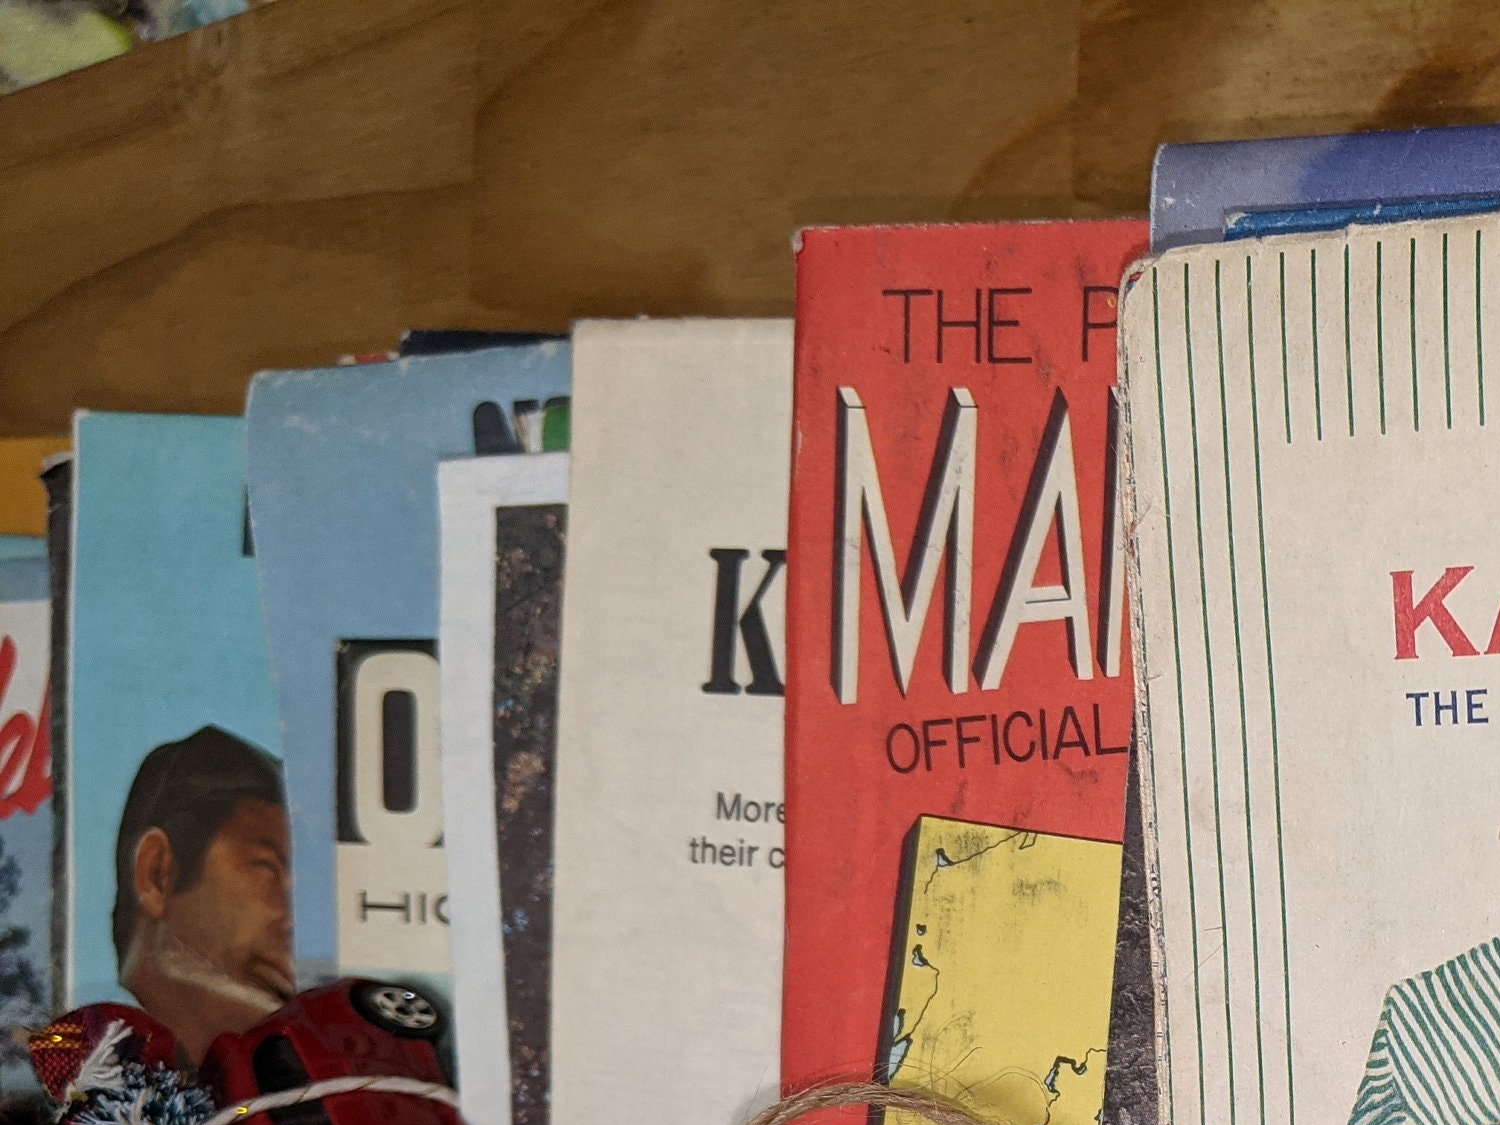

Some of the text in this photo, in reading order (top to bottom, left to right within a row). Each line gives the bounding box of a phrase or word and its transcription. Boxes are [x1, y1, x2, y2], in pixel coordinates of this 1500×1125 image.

[882, 286, 1032, 364] THE
[1405, 688, 1489, 727] THE
[885, 702, 1128, 774] OFFICIAL
[689, 835, 759, 867] their
